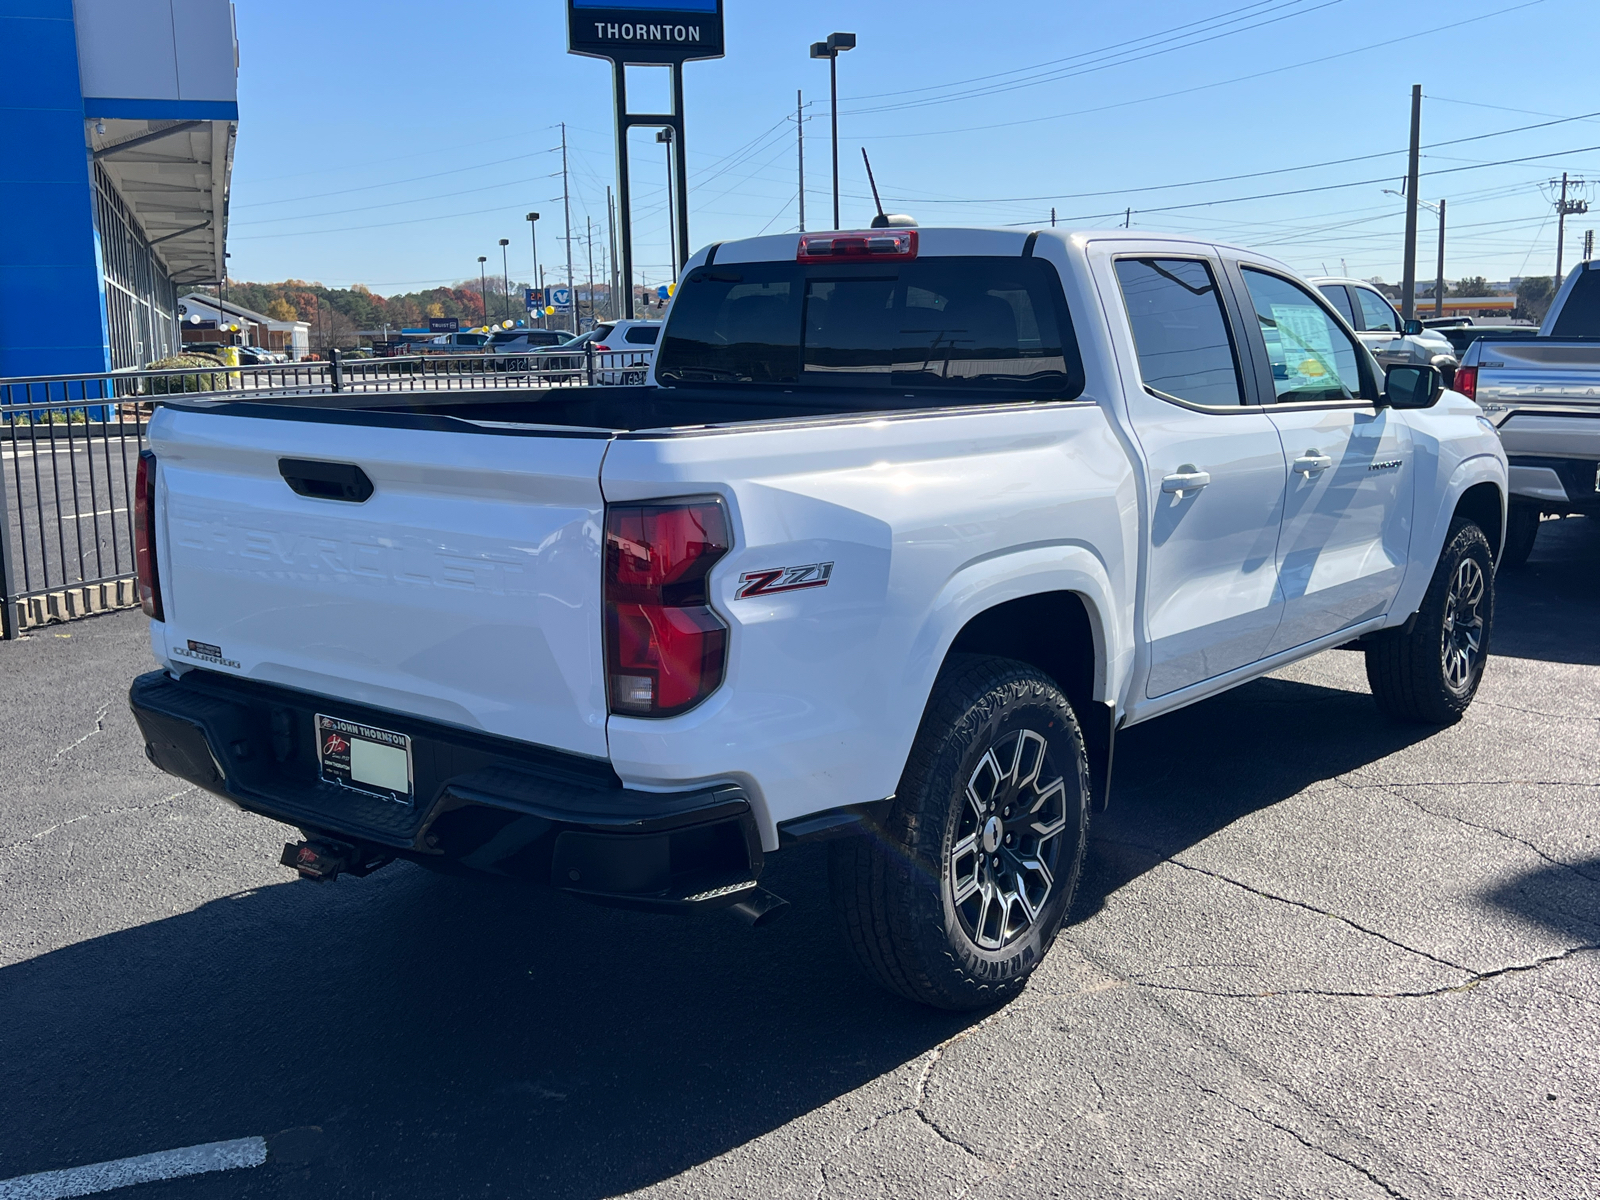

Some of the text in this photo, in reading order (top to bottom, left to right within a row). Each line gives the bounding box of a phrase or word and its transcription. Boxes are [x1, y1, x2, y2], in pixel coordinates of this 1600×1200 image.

[594, 22, 700, 42] THORNTON
[734, 561, 834, 601] Z71
[337, 722, 359, 734] JOHN
[360, 728, 405, 745] THORNTON
